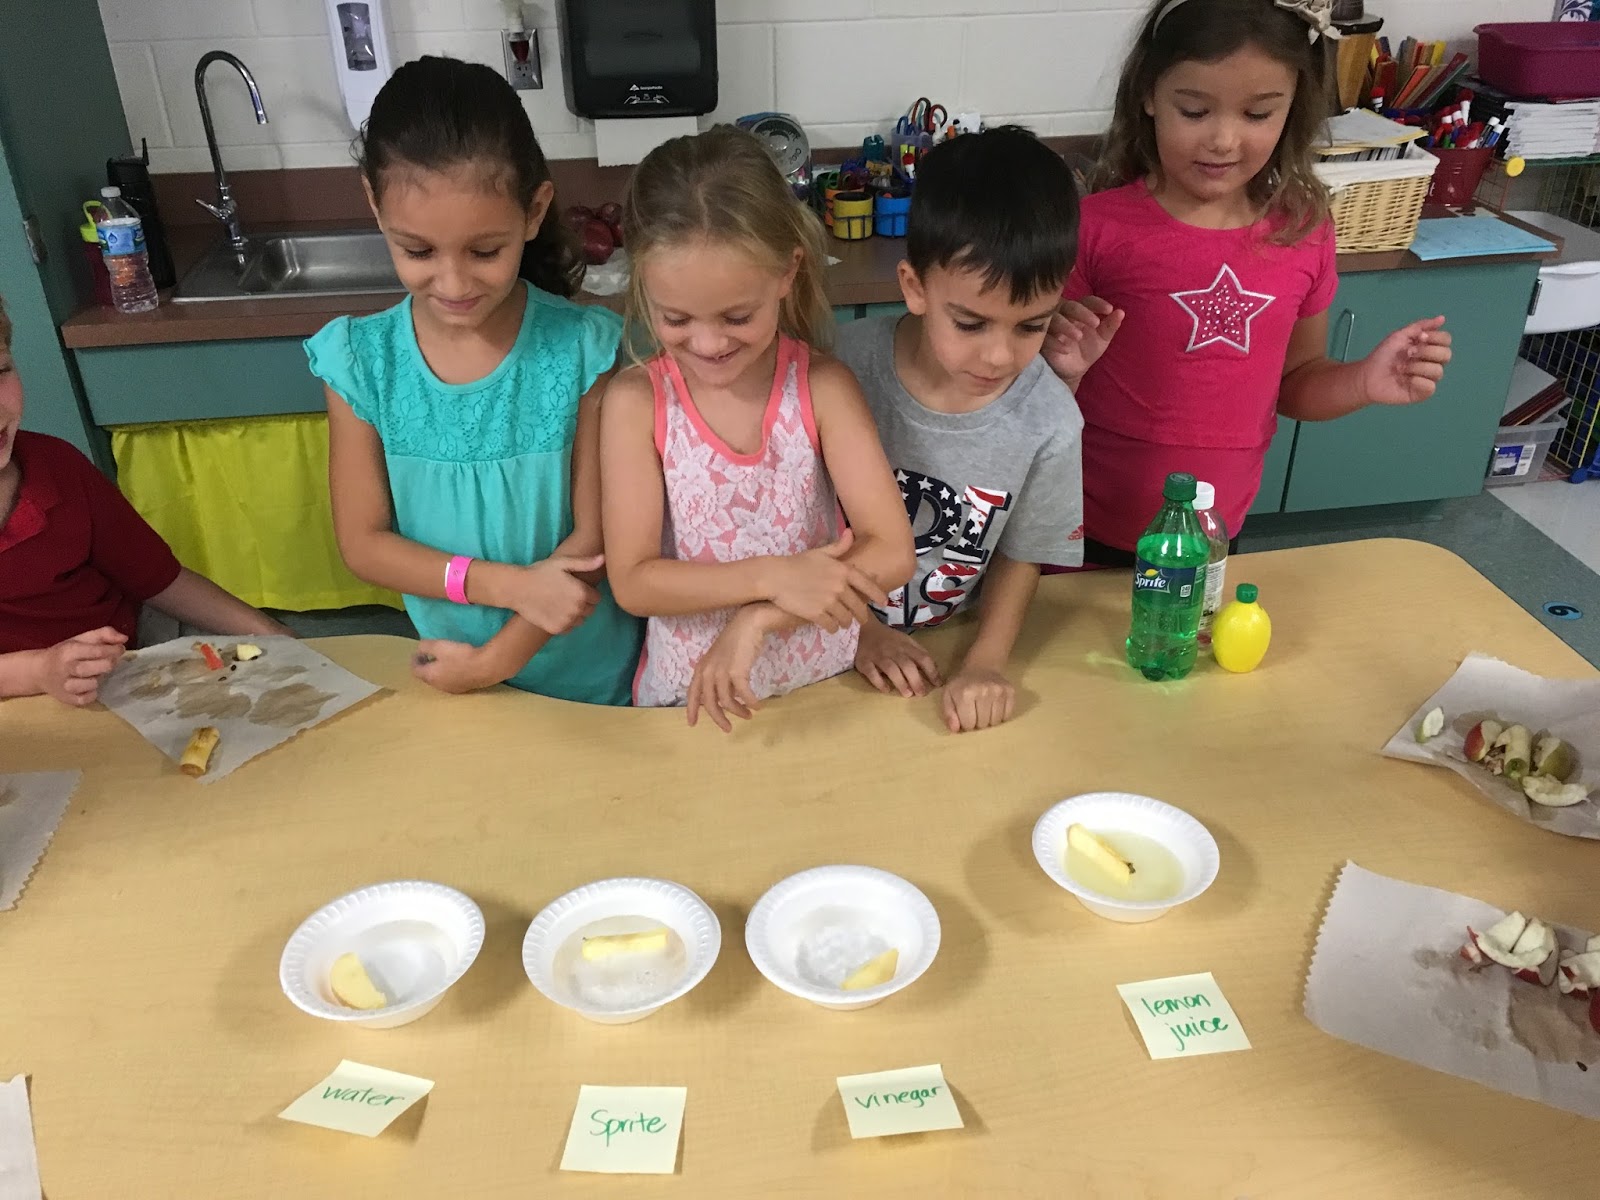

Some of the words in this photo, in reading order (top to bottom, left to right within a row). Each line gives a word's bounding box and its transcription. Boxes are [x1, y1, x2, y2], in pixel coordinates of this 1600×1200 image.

[1135, 572, 1166, 588] Sprite
[1140, 993, 1211, 1018] lemon
[1164, 1016, 1228, 1052] juice
[322, 1085, 406, 1106] water
[854, 1085, 944, 1109] vinegar
[589, 1108, 667, 1148] Sprite
